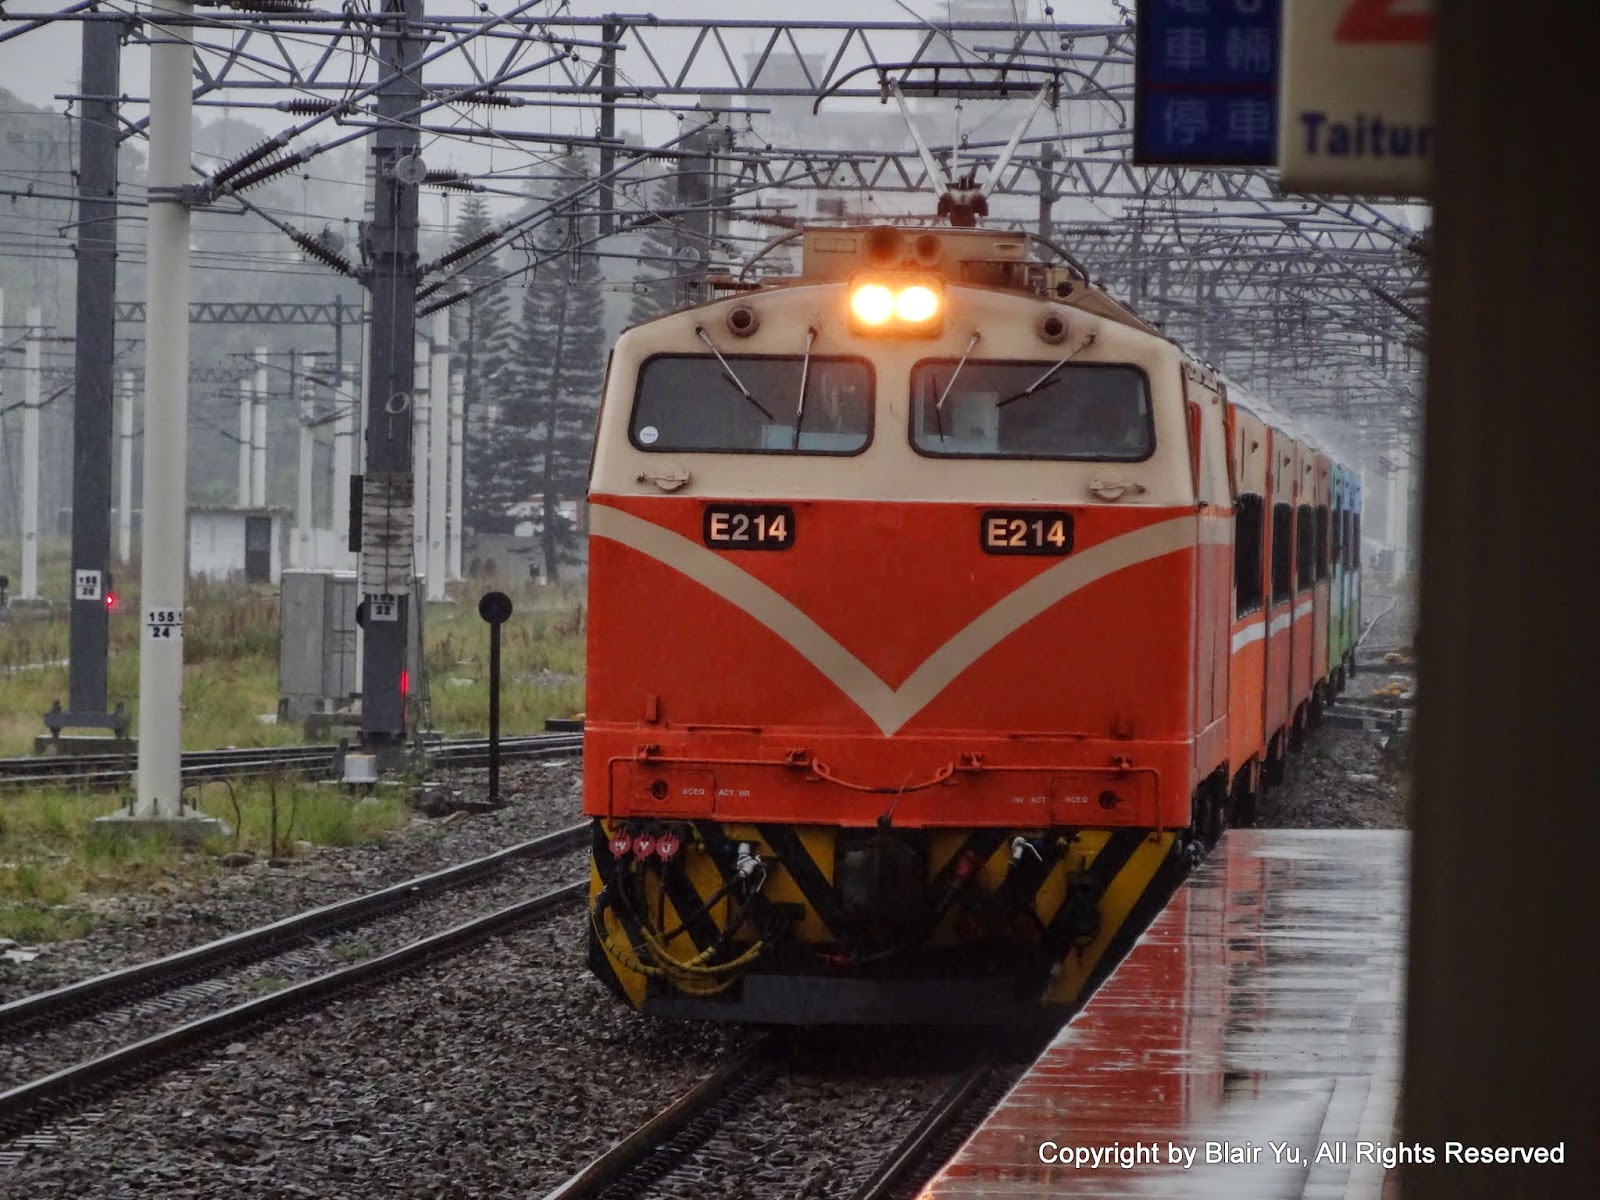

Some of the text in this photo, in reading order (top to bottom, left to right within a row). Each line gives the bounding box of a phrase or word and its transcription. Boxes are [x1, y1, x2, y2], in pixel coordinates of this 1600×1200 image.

[710, 512, 788, 542] E214
[987, 518, 1066, 548] E214
[149, 611, 175, 622] 155
[152, 627, 170, 638] 24
[719, 789, 734, 797] ACT
